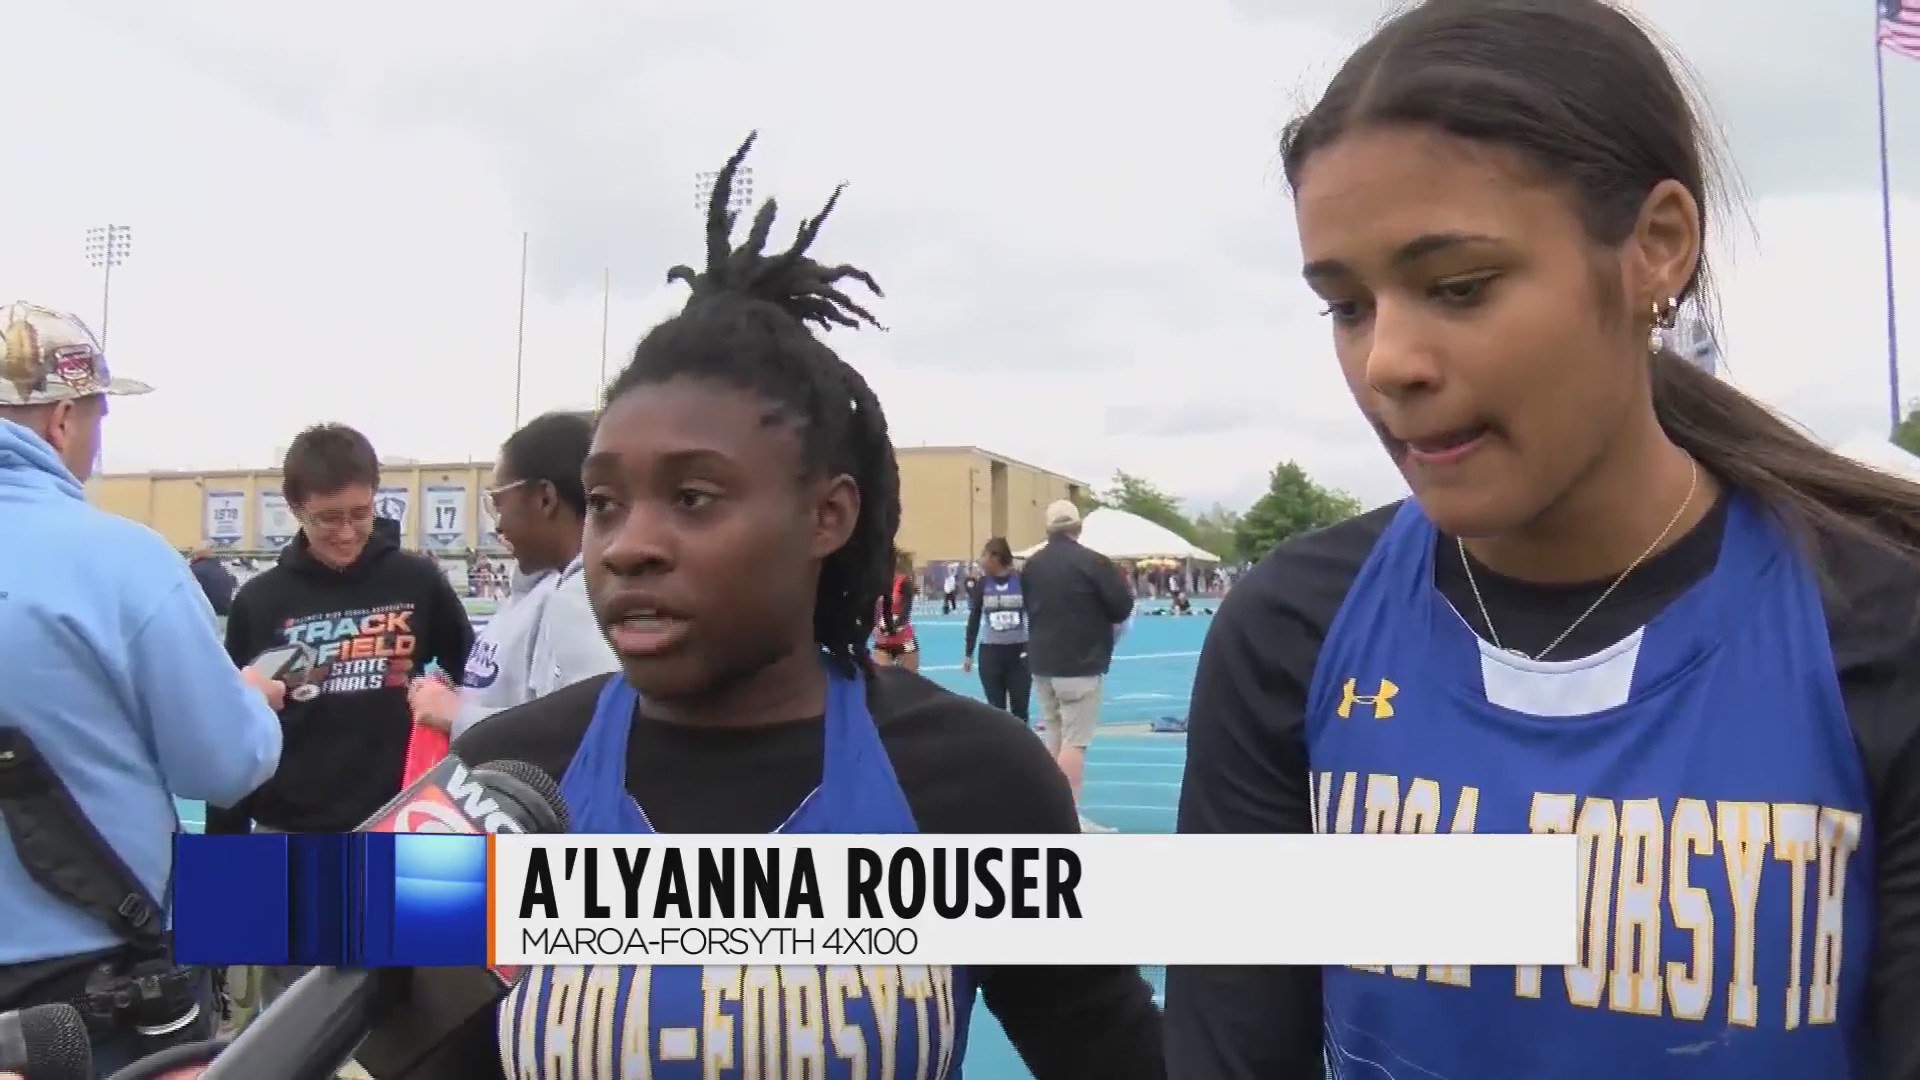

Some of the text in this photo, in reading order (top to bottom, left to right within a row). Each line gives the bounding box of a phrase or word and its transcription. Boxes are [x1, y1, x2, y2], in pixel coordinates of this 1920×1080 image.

[434, 506, 456, 529] 17
[283, 611, 414, 645] TRACK
[318, 634, 416, 666] FIELD
[331, 657, 388, 677] STATE
[322, 674, 383, 694] FINALS
